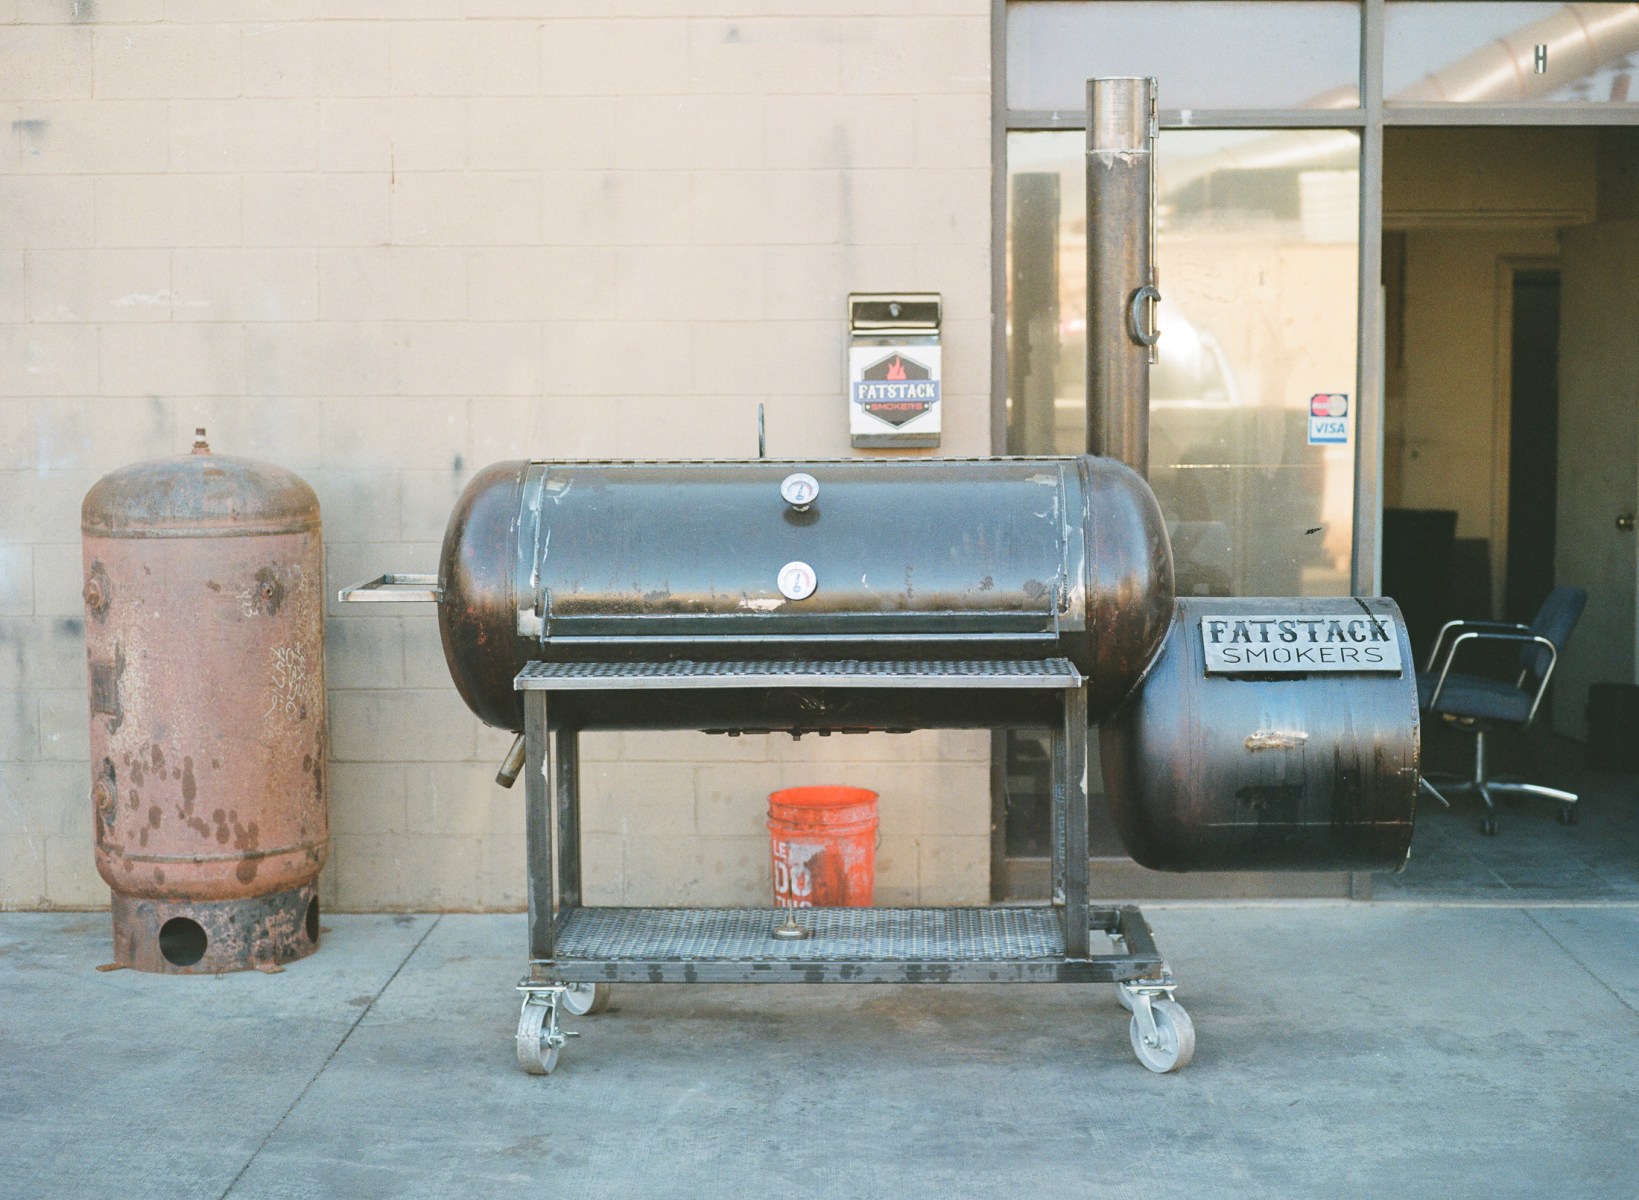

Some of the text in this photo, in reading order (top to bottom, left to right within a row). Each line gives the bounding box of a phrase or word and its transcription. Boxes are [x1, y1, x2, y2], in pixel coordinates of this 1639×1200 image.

[1534, 44, 1547, 74] H
[858, 383, 936, 399] FATSTACK
[870, 402, 924, 411] SMOKERS
[1315, 422, 1345, 434] VISA
[1207, 619, 1391, 644] FATSTACK
[1222, 647, 1384, 664] SMOKERS
[774, 860, 812, 897] DO
